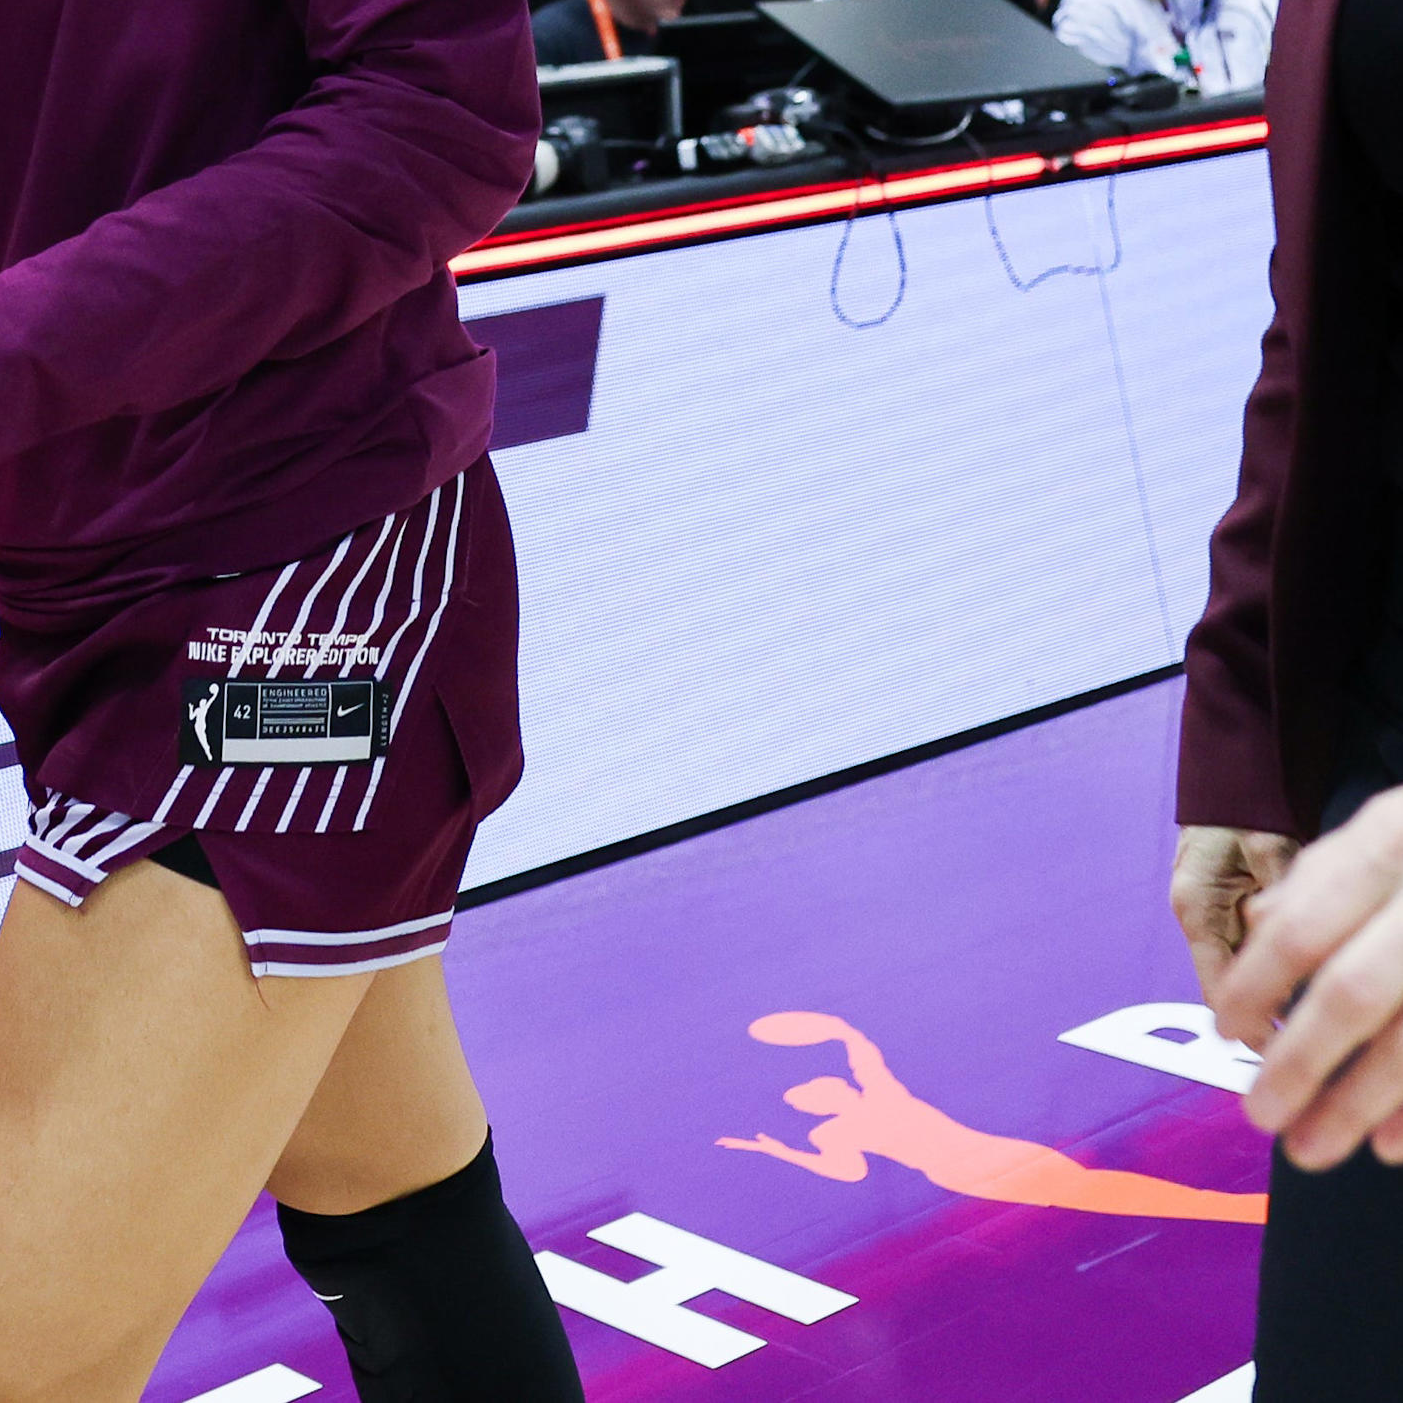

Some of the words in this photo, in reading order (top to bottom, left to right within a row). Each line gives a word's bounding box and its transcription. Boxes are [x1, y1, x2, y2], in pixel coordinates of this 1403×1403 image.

[206, 627, 302, 646] TORONTO
[307, 633, 370, 647] TEMPO
[188, 641, 227, 663] NIKE
[231, 646, 317, 666] EXPLORER
[320, 645, 381, 666] EDITION
[262, 687, 327, 698] ENGINEERED
[233, 704, 251, 720] 42
